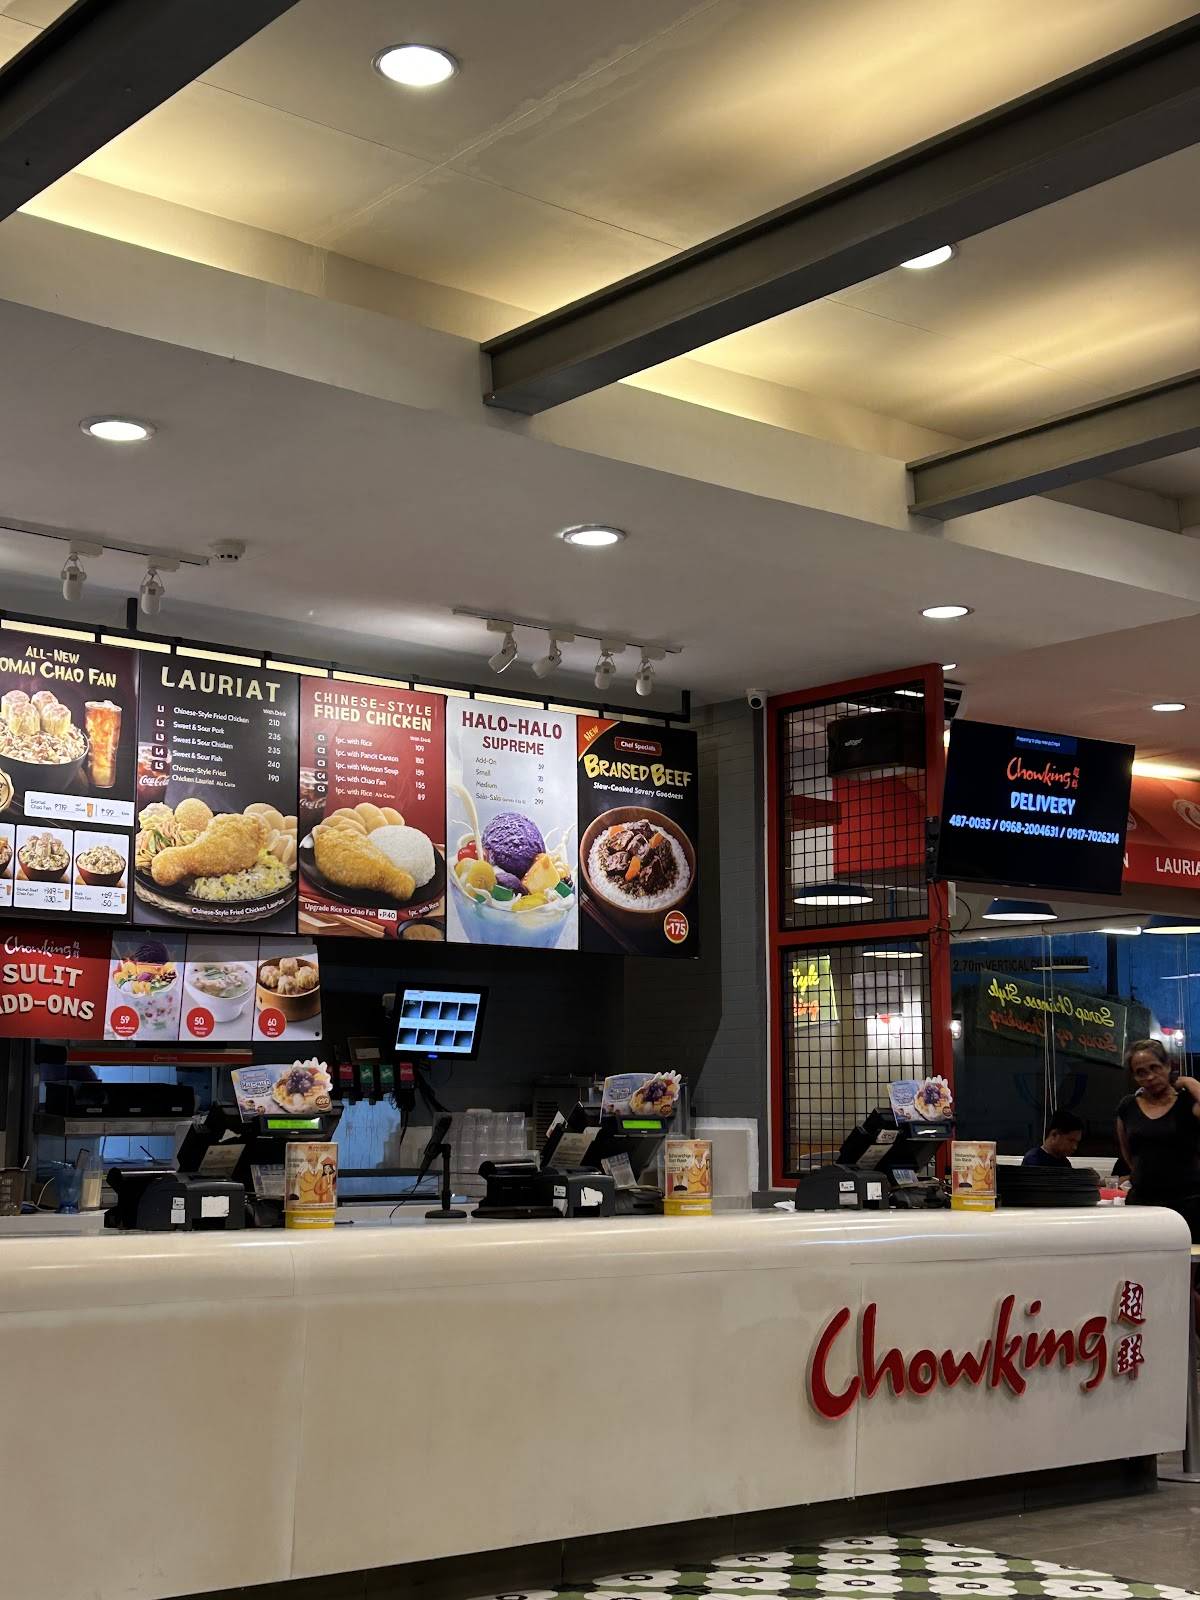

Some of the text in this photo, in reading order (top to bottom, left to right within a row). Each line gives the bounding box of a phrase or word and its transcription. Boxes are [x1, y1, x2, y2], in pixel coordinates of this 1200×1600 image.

[25, 645, 80, 665] ALL-NEW
[40, 661, 84, 683] CHAO
[88, 668, 117, 688] FAN
[161, 666, 281, 702] LAURIAT
[314, 691, 432, 717] CHINESE-STYLE
[156, 719, 165, 727] L2
[173, 721, 191, 730] Sweet
[197, 724, 211, 732] Sour
[211, 726, 225, 735] Pork
[173, 706, 213, 719] Chinese-Style
[212, 713, 227, 721] Fried
[227, 714, 250, 724] Chicken
[268, 718, 280, 727] 210
[313, 703, 432, 732] FRIED CHICKEN
[462, 710, 563, 740] HALO-HALO
[155, 733, 165, 741] L3
[172, 735, 191, 744] Sweet
[197, 739, 211, 747] Sour
[211, 740, 233, 750] Chicken
[482, 735, 544, 756] SUPREME
[155, 747, 164, 756] L4
[172, 749, 191, 758] Sweet
[196, 753, 211, 761] Sour
[211, 754, 223, 763] Fish
[267, 760, 281, 769] 240
[171, 774, 195, 783] Chicken
[172, 764, 212, 775] Chinese-Style
[212, 769, 227, 777] Fried
[268, 773, 280, 782] 190
[650, 763, 693, 787] BEEF
[1006, 756, 1071, 790] Chowking
[592, 781, 634, 794] Slow-Cooked
[634, 786, 656, 798] Savory
[1010, 791, 1076, 816] DELIVERY
[949, 814, 991, 831] 487-0035
[999, 819, 1059, 838] 0968-2004631
[191, 907, 229, 917] Chinese-Style
[244, 905, 267, 914] Chicken
[304, 902, 330, 913] Upgrade
[330, 904, 343, 913] Rice
[4, 935, 72, 959] Chowking
[3, 963, 84, 988] SULIT
[0, 993, 95, 1020] DD-ONS
[120, 1015, 130, 1025] 59
[193, 1017, 205, 1026] 50
[267, 1018, 277, 1027] 60
[809, 1293, 1108, 1421] Chowking
